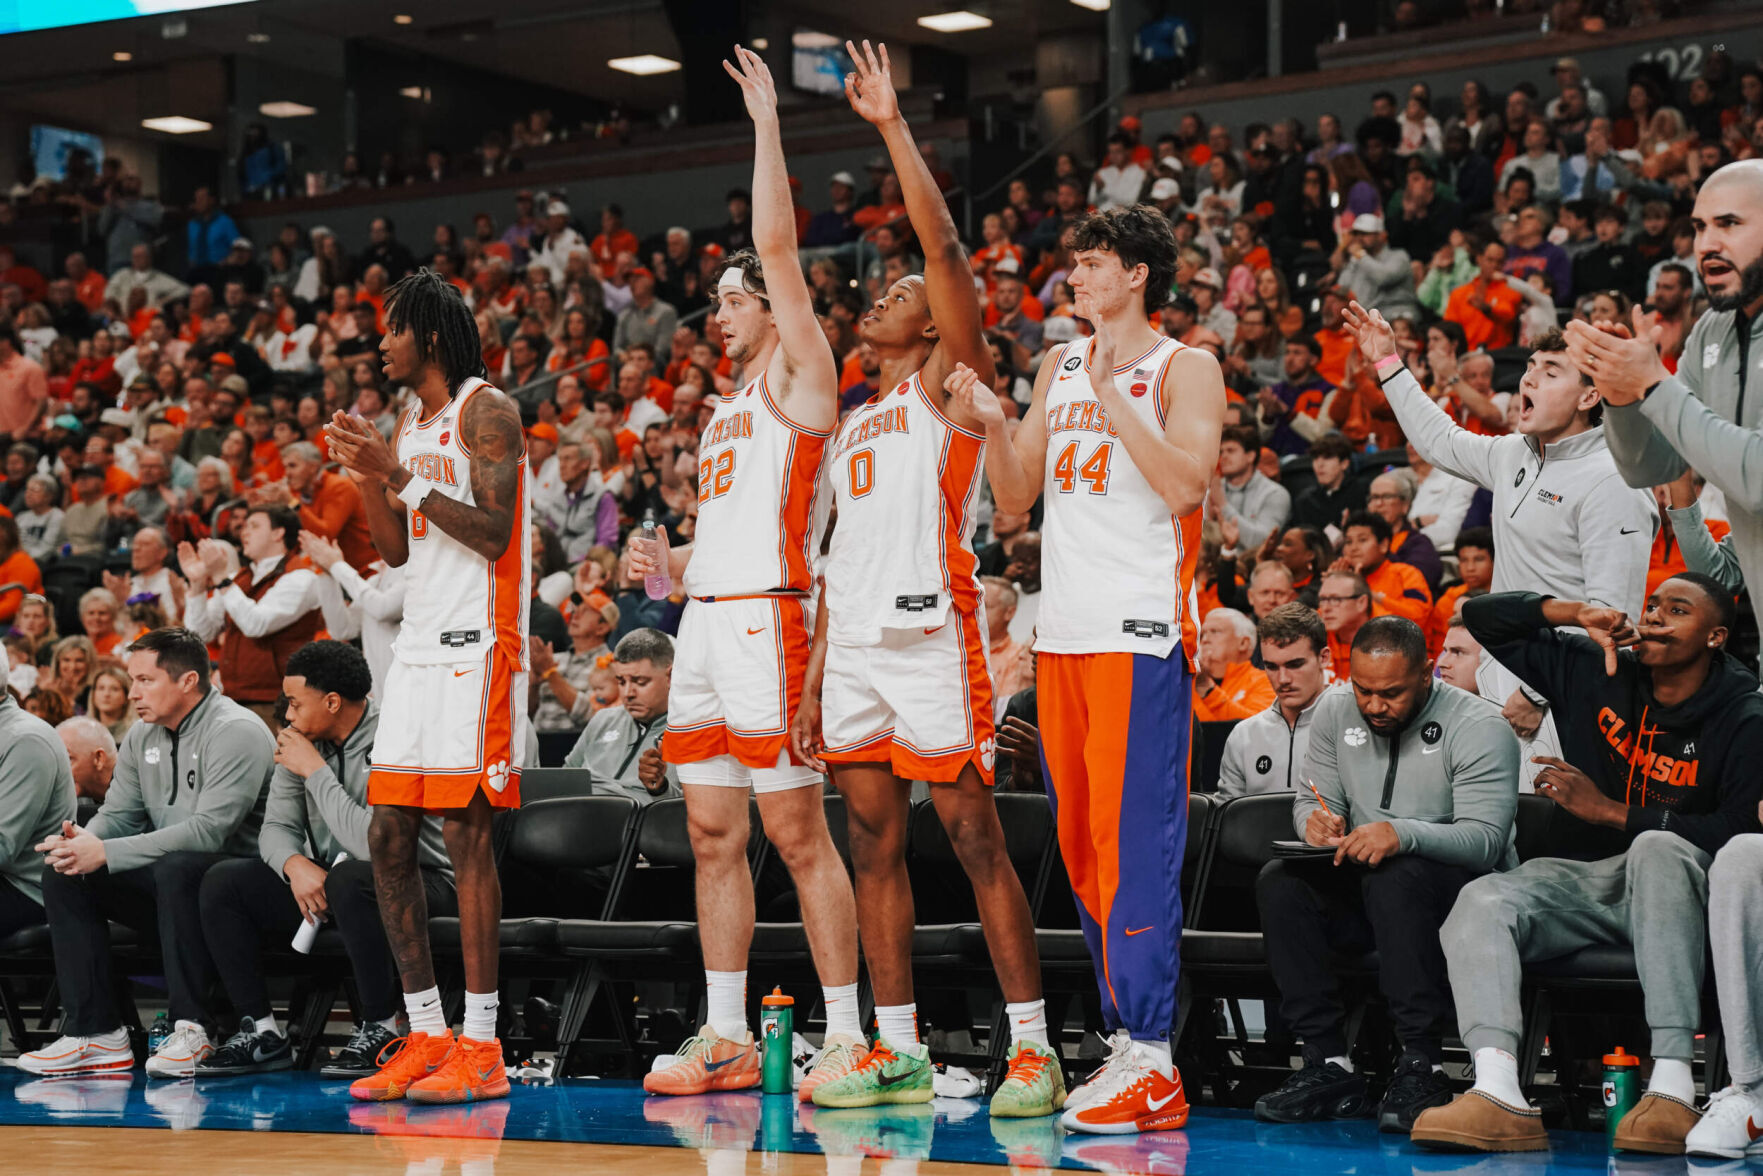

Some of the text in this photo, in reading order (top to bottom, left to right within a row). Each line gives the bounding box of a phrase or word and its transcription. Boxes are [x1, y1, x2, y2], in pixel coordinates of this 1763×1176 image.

[1640, 43, 1702, 80] 02
[701, 411, 753, 450] MSON
[833, 405, 909, 464] EMSON
[1047, 400, 1119, 438] CLEMS
[402, 453, 458, 487] EMSON
[698, 446, 736, 508] 22
[848, 447, 875, 500] 0
[1054, 440, 1114, 495] 44
[1425, 726, 1438, 739] 41
[1683, 742, 1696, 755] 41
[1259, 760, 1268, 769] 41
